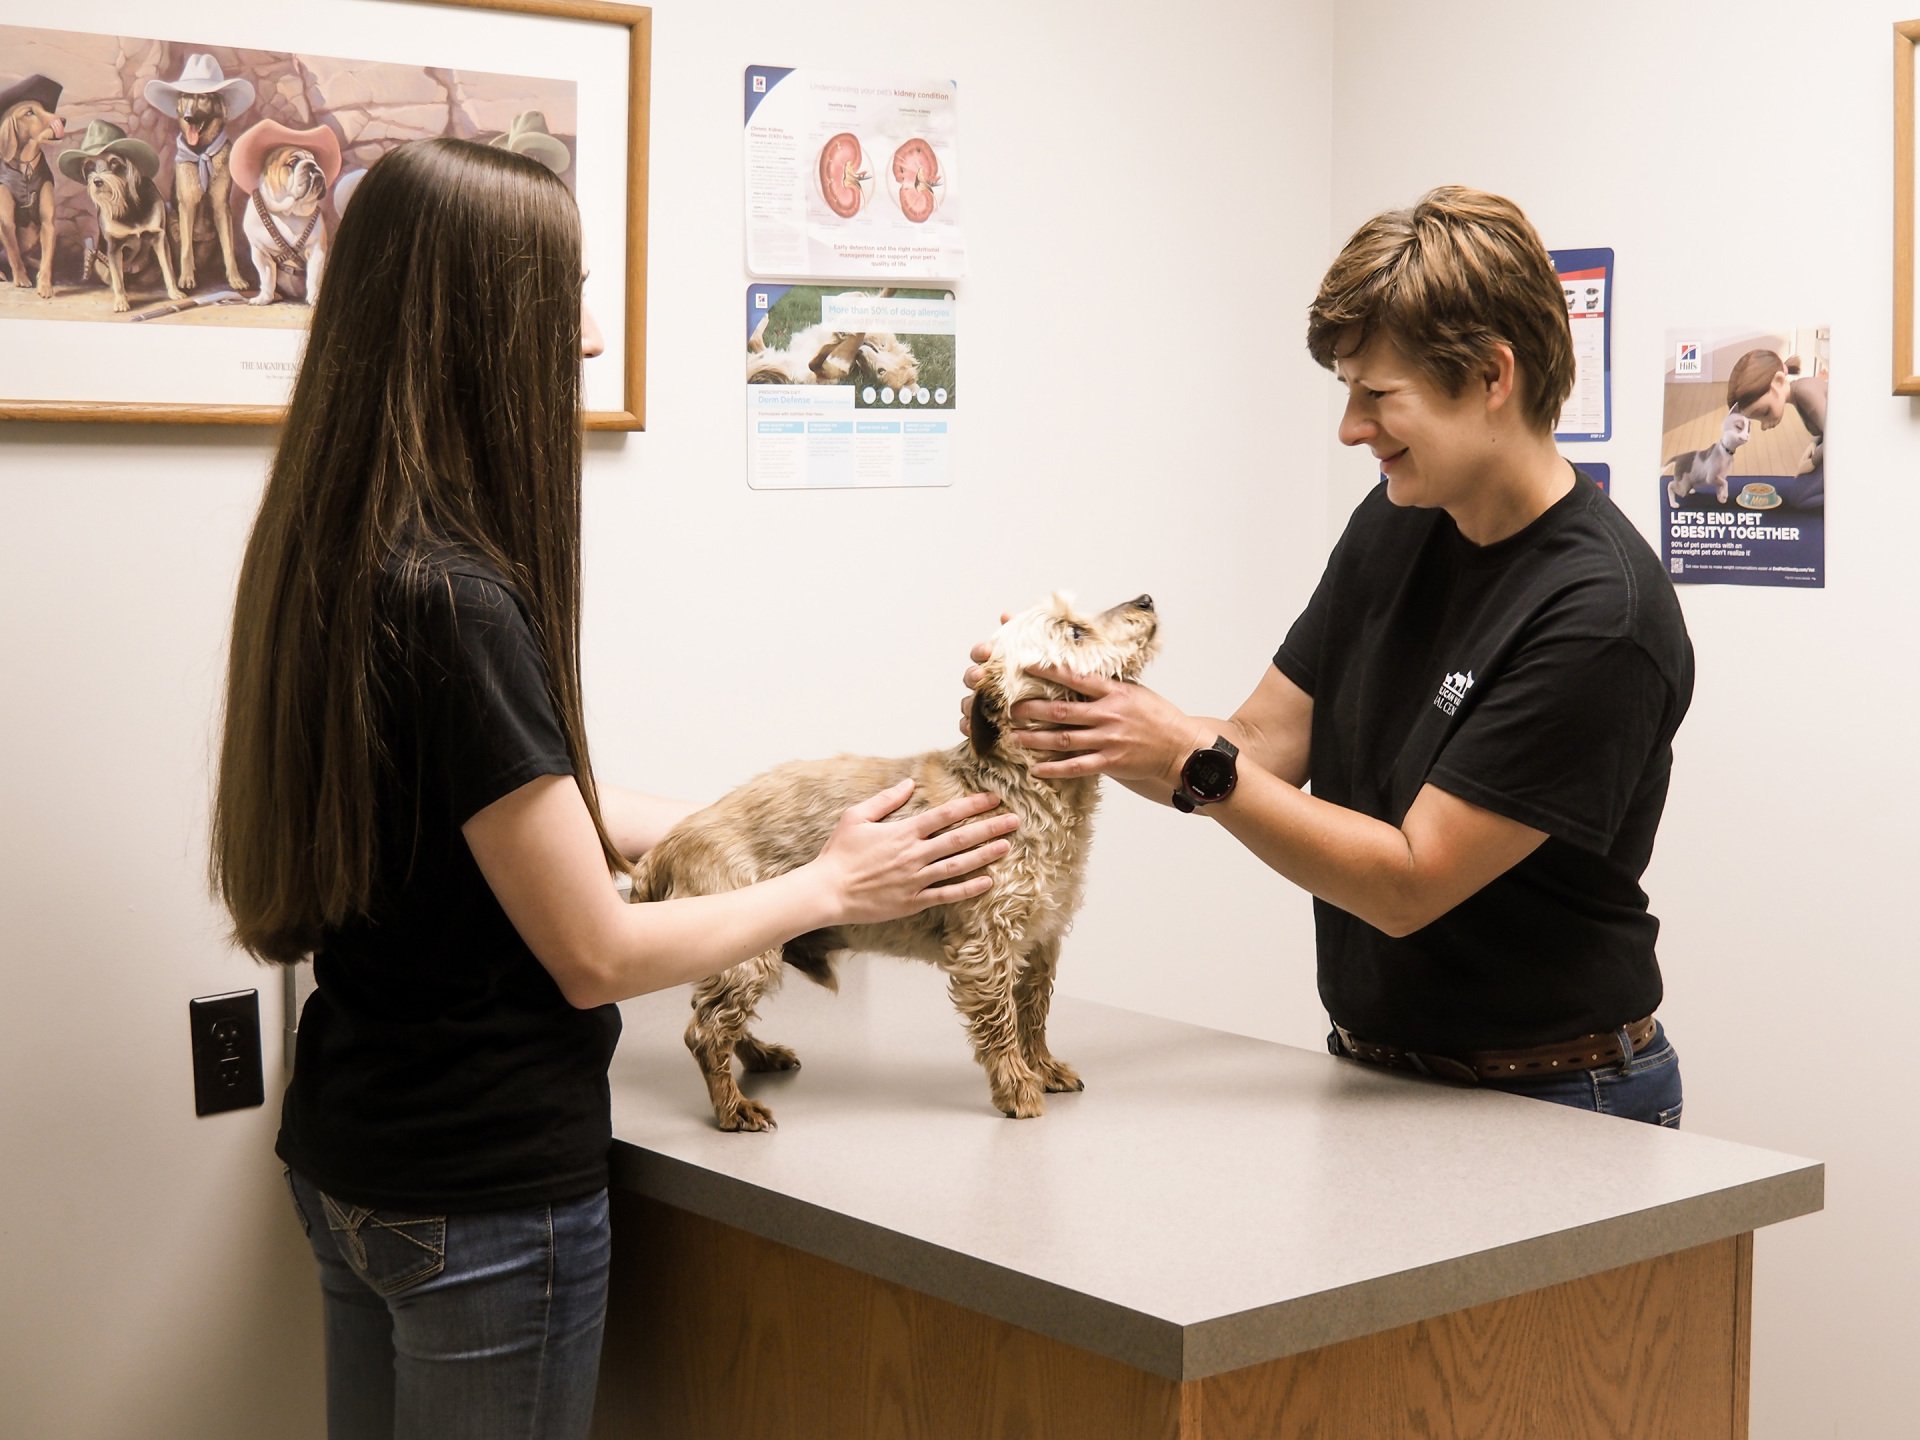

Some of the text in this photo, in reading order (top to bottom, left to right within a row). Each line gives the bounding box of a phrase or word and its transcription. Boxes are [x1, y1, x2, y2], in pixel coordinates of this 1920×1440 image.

[810, 82, 859, 95] Understanding
[860, 87, 876, 96] your
[893, 89, 916, 100] kidney
[917, 91, 949, 101] condition
[833, 243, 848, 251] Early
[898, 245, 911, 253] right
[839, 252, 875, 260] management
[887, 253, 908, 261] support
[828, 304, 950, 318] More than 50% of dog allergies
[240, 361, 298, 371] THE MAGNIFICEN
[758, 395, 780, 404] Derm
[780, 396, 811, 404] Defense
[1670, 511, 1762, 526] LET'S END PET
[1670, 526, 1800, 540] OBESITY TOGETHER
[1690, 542, 1700, 550] pet
[1700, 542, 1721, 550] parents
[1670, 549, 1700, 557] overweight
[1701, 549, 1711, 557] pet
[1727, 549, 1745, 557] realize
